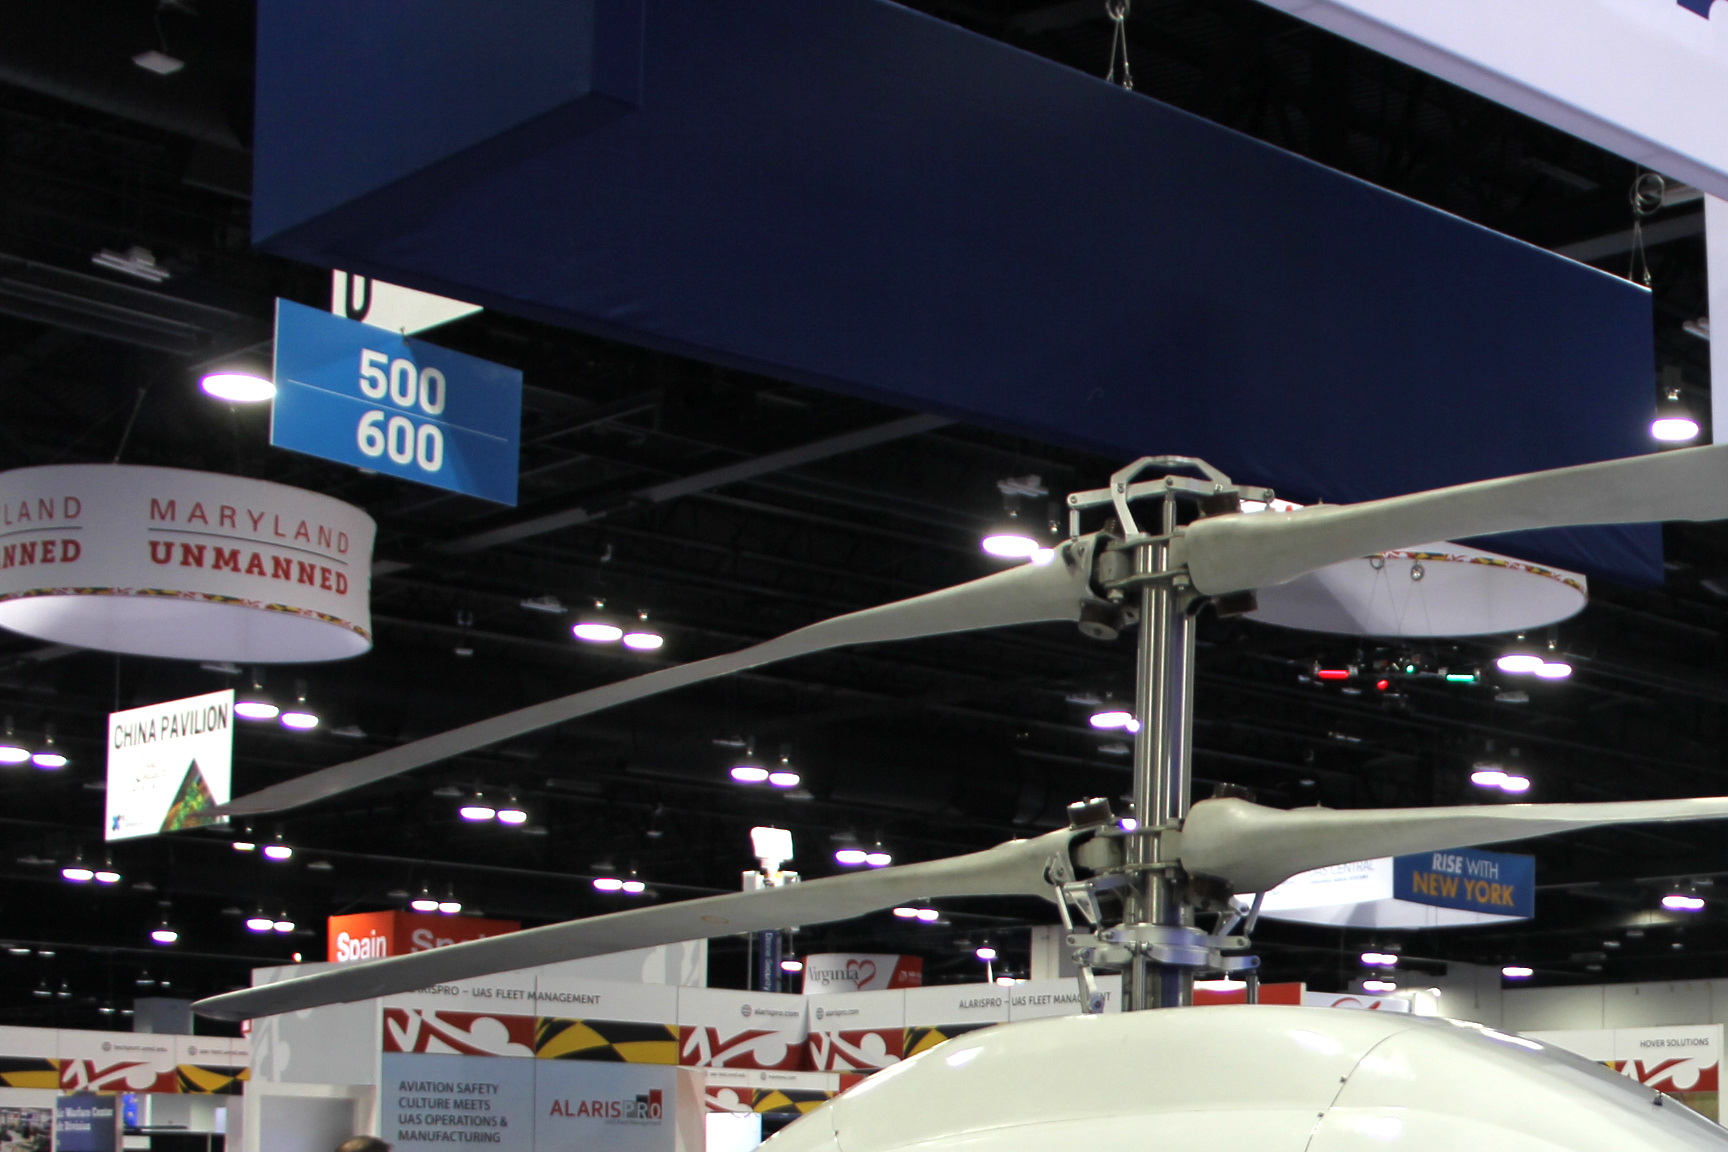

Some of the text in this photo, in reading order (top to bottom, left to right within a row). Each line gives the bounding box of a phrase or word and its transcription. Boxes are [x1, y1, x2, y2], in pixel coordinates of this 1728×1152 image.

[359, 347, 446, 416] 500
[356, 409, 444, 473] 600
[151, 498, 349, 554] MARYLAND
[148, 540, 348, 595] UNMANNED
[114, 703, 228, 749] CHINA PAVILION
[1432, 852, 1499, 880] RISE WITH
[1413, 870, 1514, 906] NEW YORK
[336, 929, 388, 962] Spain
[808, 966, 860, 986] Virginia
[472, 987, 493, 998] UAS
[496, 989, 525, 1000] FLEET
[527, 991, 601, 1005] MANAGEMENT
[959, 997, 1002, 1009] ALARISPRO
[1012, 996, 1027, 1006] UAS
[1029, 995, 1051, 1006] FLEET
[1640, 1038, 1709, 1048] HOVER SOLUTIONS
[399, 1081, 499, 1095] AVIATION SAFETY
[398, 1097, 491, 1110] CULTURE MEETS
[398, 1113, 508, 1127] UAS OPERATIONS &
[398, 1129, 501, 1143] MANUFACTURING
